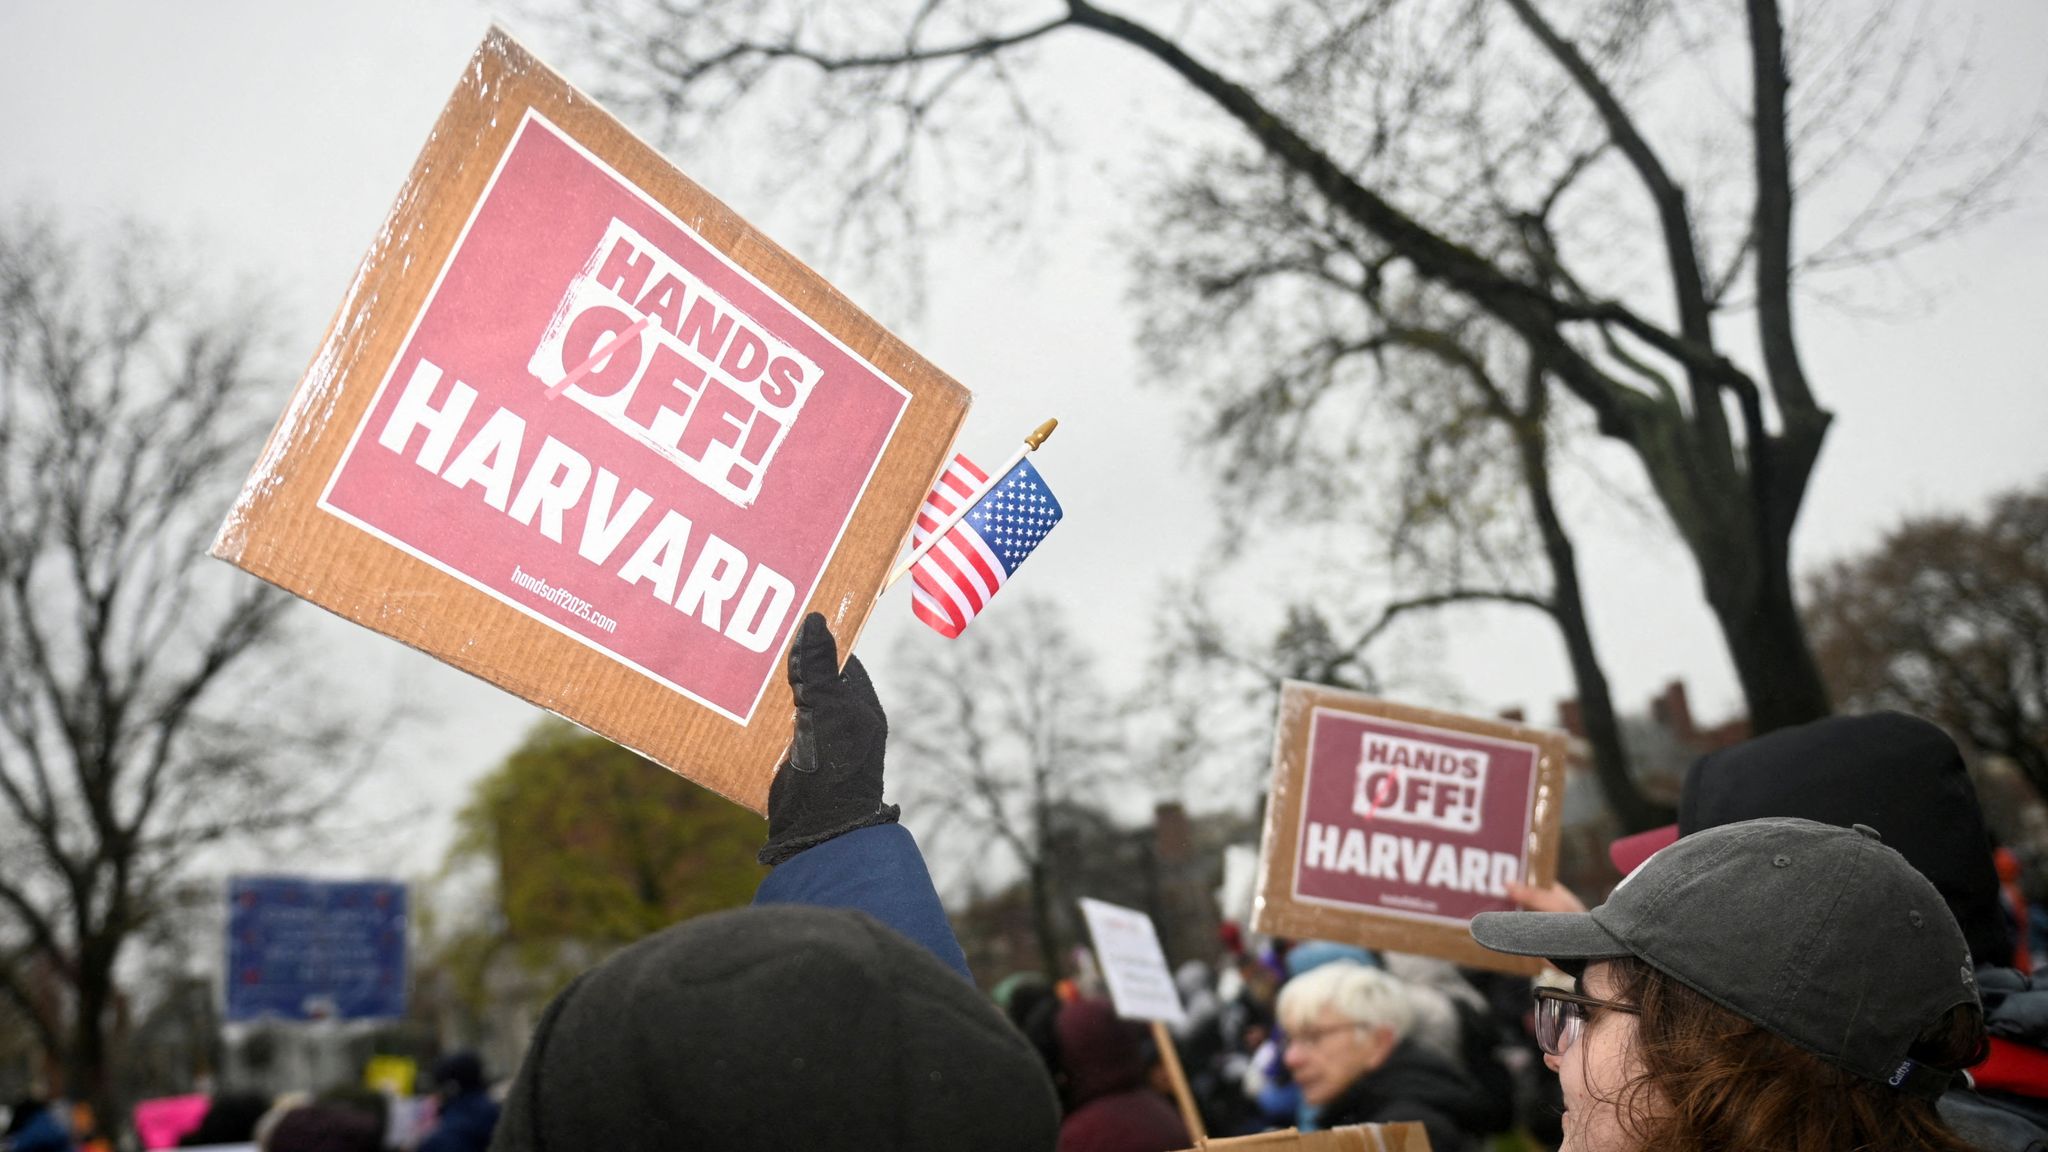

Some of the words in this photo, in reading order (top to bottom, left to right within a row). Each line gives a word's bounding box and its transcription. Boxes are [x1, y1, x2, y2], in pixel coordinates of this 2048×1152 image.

[596, 236, 805, 409] HANDS
[560, 304, 783, 492] OFF!
[378, 357, 796, 654] HARVARD
[510, 564, 618, 634] handsoff2025.com
[1365, 770, 1477, 824] OFF!
[1367, 739, 1479, 780] HANDS
[1304, 822, 1520, 897] HARVARD
